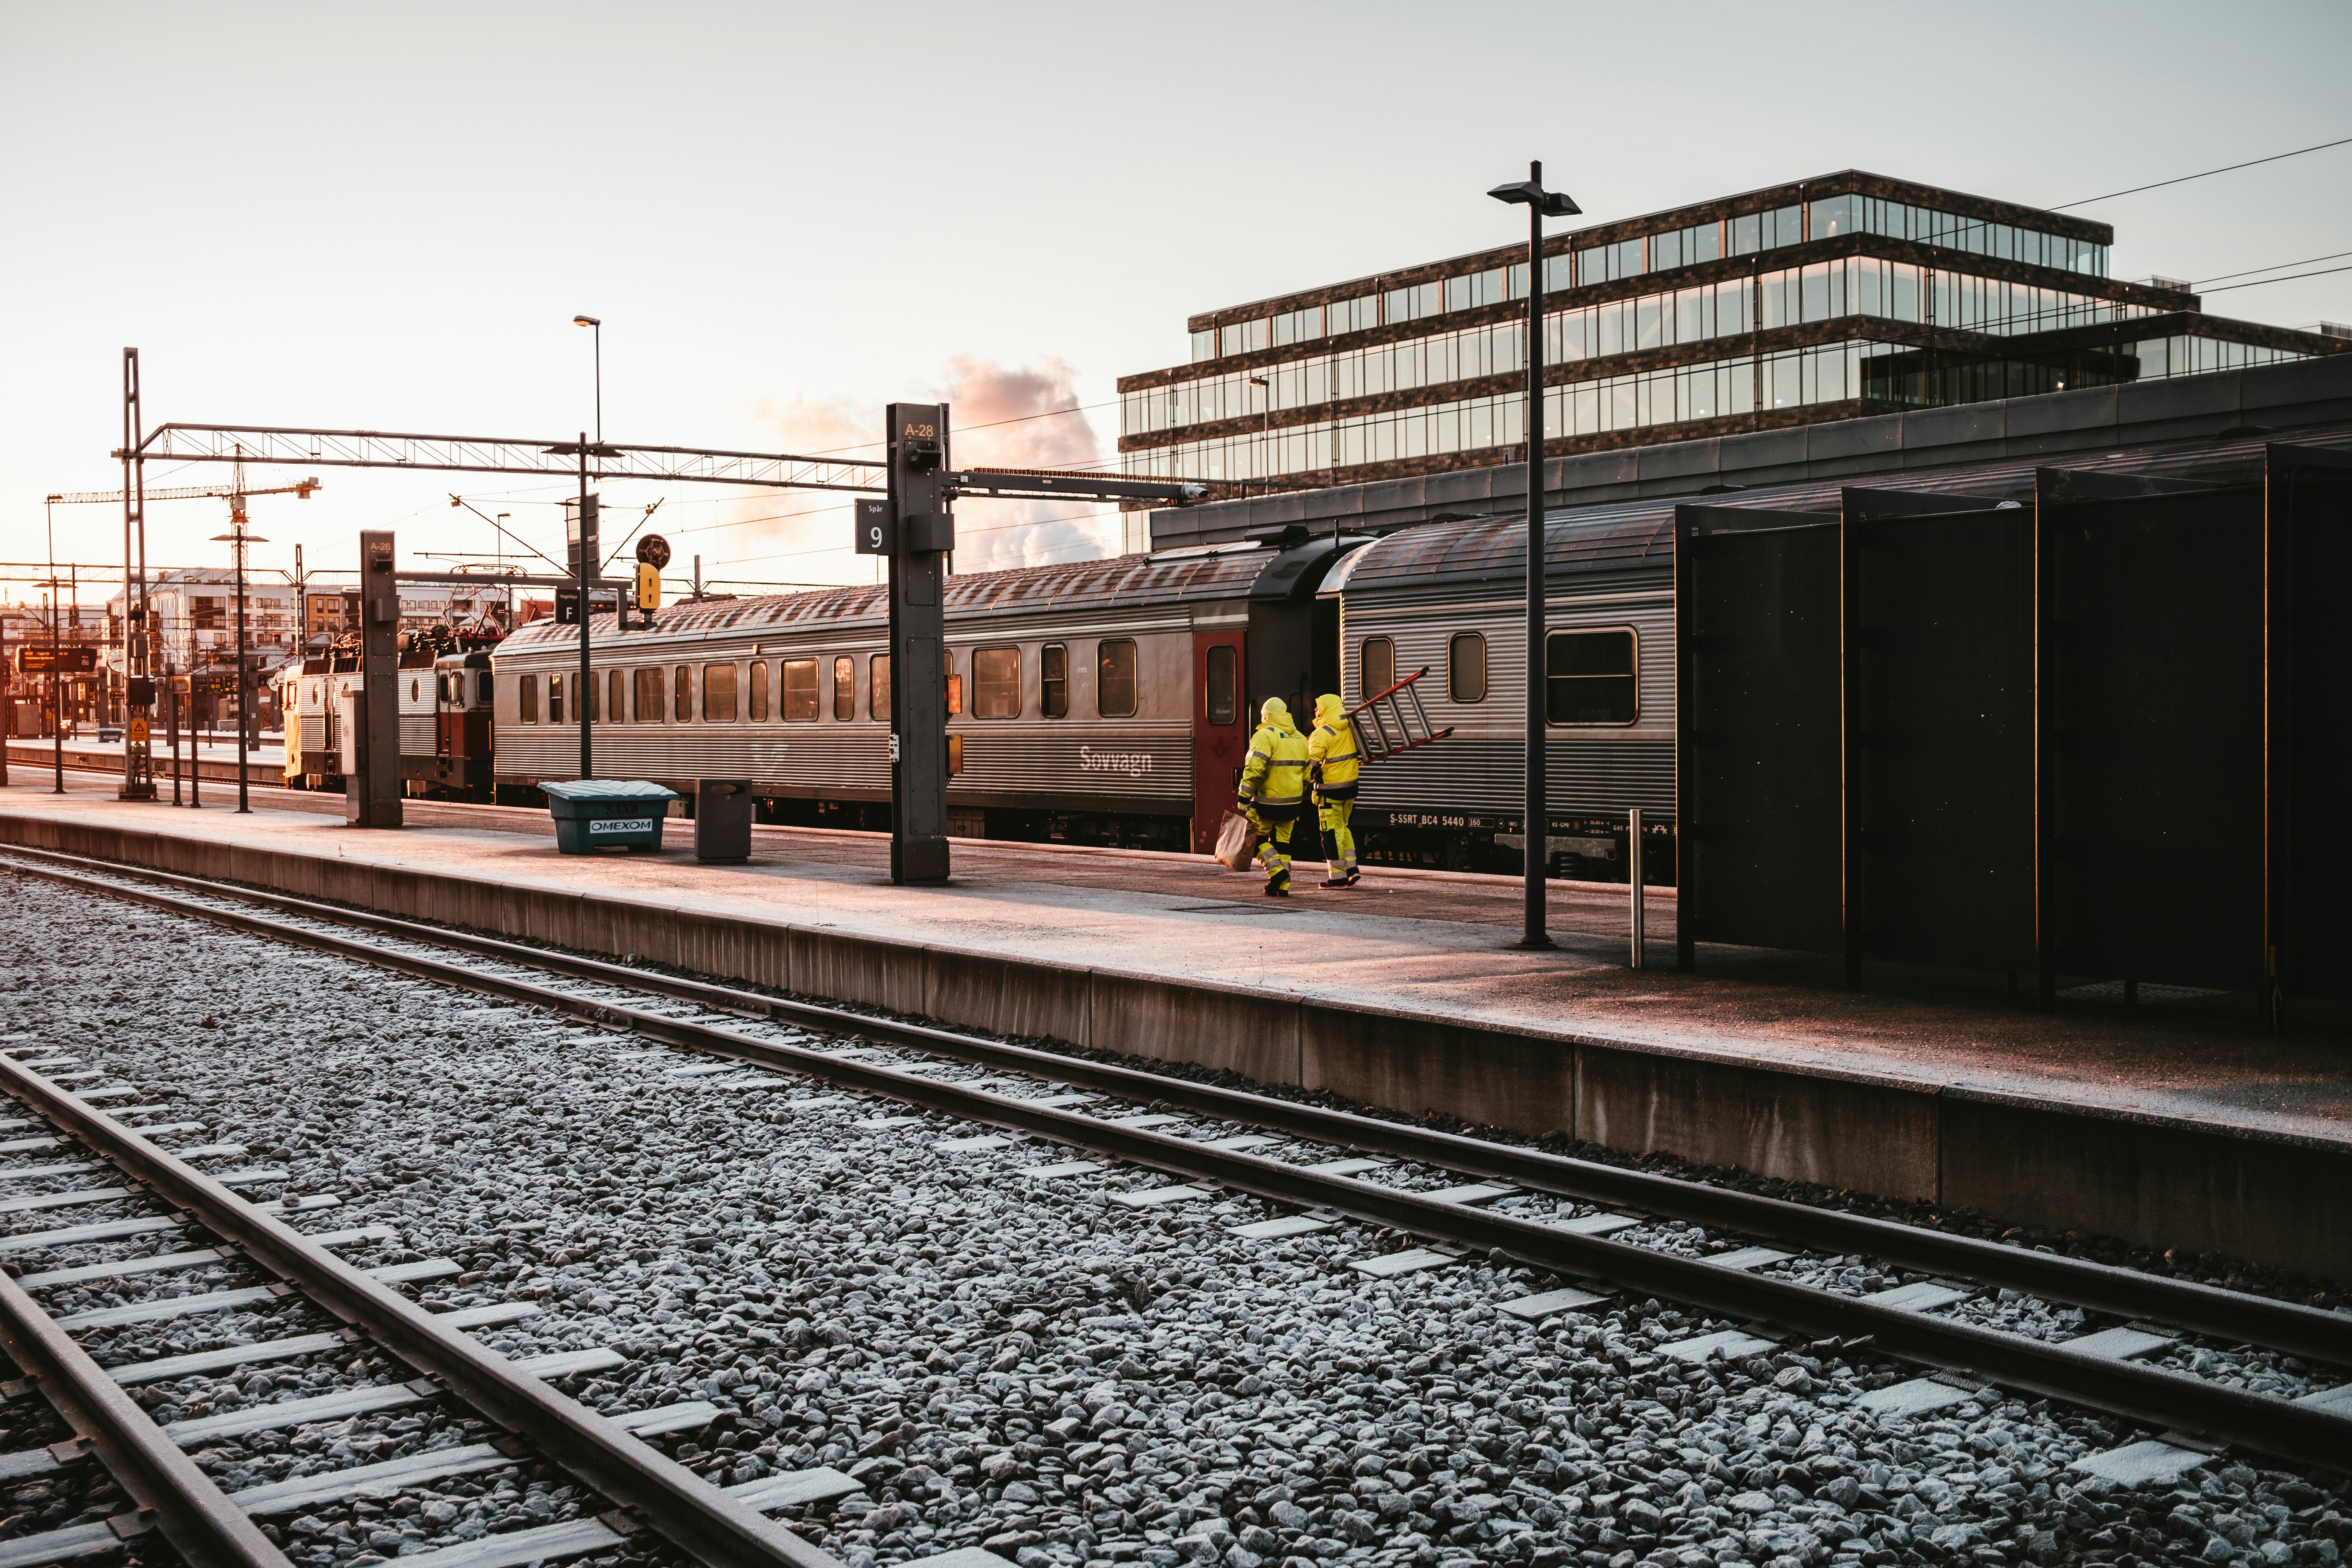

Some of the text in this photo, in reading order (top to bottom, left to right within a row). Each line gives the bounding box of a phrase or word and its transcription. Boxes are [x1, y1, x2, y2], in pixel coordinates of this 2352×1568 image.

[905, 424, 933, 437] A-28
[869, 505, 882, 513] Spår
[871, 527, 882, 548] 9
[567, 607, 573, 619] F
[1080, 746, 1152, 776] Sovvagn
[606, 803, 639, 815] SAND
[591, 820, 651, 831] OMEXOM
[1390, 813, 1464, 826] S-SSRT BC4 5440
